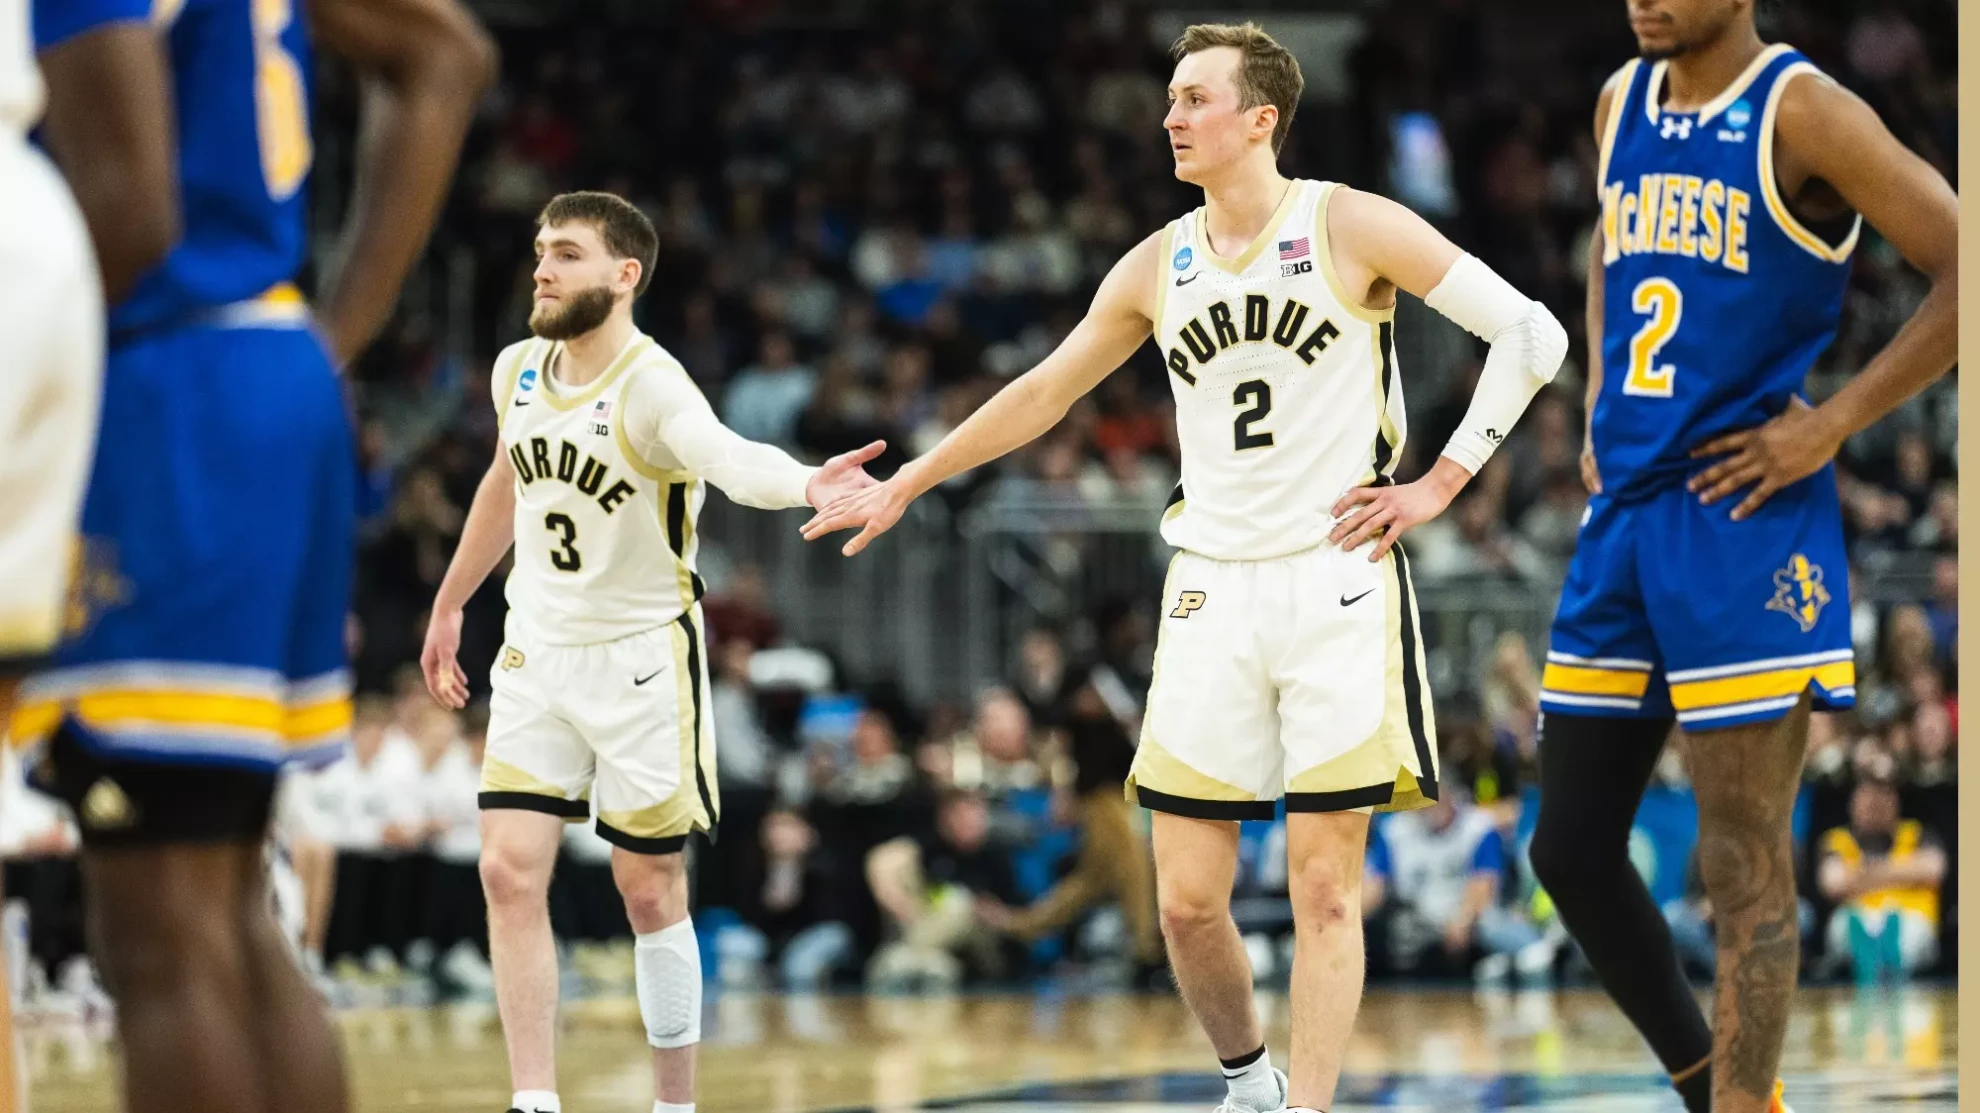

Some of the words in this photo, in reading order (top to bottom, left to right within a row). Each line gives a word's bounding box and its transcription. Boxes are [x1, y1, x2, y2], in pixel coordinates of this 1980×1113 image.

[1167, 293, 1342, 388] PURDUE
[1622, 276, 1684, 398] 2
[1233, 378, 1275, 452] 2
[509, 436, 638, 515] URDUE
[545, 512, 582, 573] 3
[1169, 590, 1206, 619] P
[501, 645, 526, 671] P
